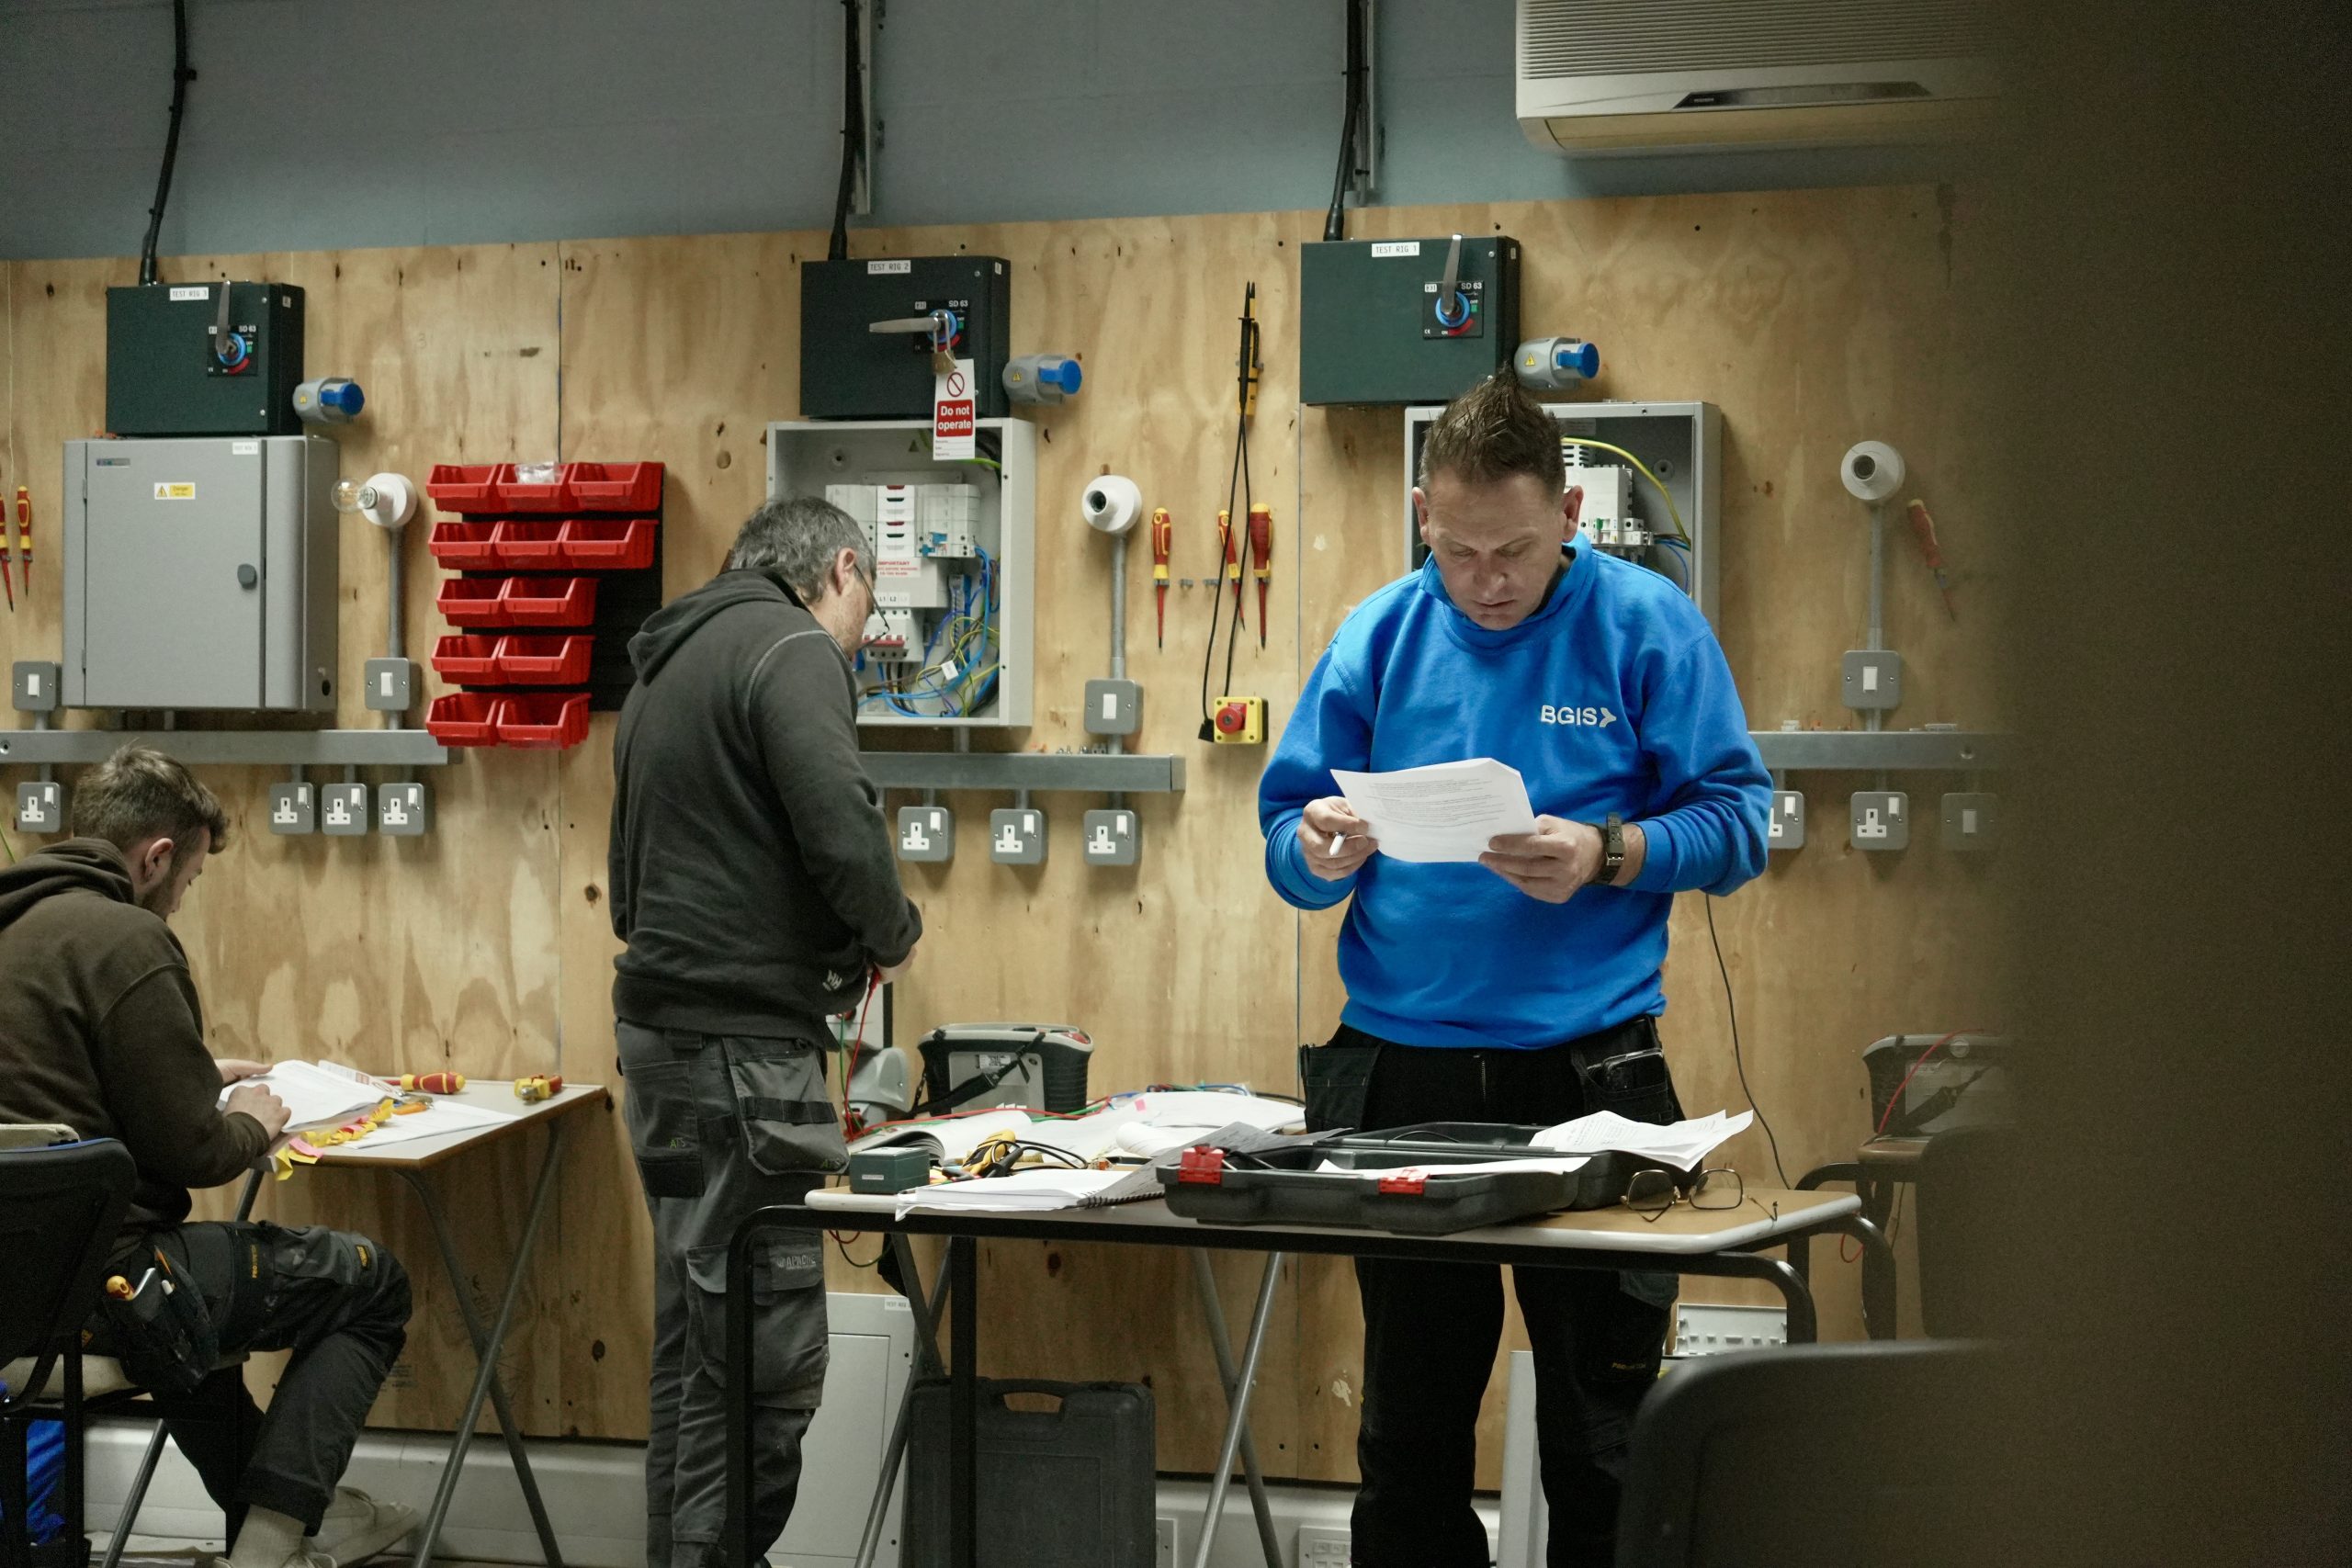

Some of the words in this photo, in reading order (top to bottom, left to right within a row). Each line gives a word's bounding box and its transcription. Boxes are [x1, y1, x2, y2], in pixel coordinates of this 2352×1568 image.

[1376, 245, 1391, 254] TEST
[1396, 244, 1409, 253] RIG
[870, 263, 885, 271] TEST
[888, 263, 901, 271] RIG
[1461, 282, 1472, 290] SD
[1473, 282, 1482, 290] 63
[172, 290, 186, 299] TEST
[948, 299, 959, 308] SD
[960, 299, 968, 308] 63
[941, 406, 954, 416] Do
[956, 405, 970, 415] not
[937, 420, 972, 433] operate
[1541, 705, 1598, 726] BGIS
